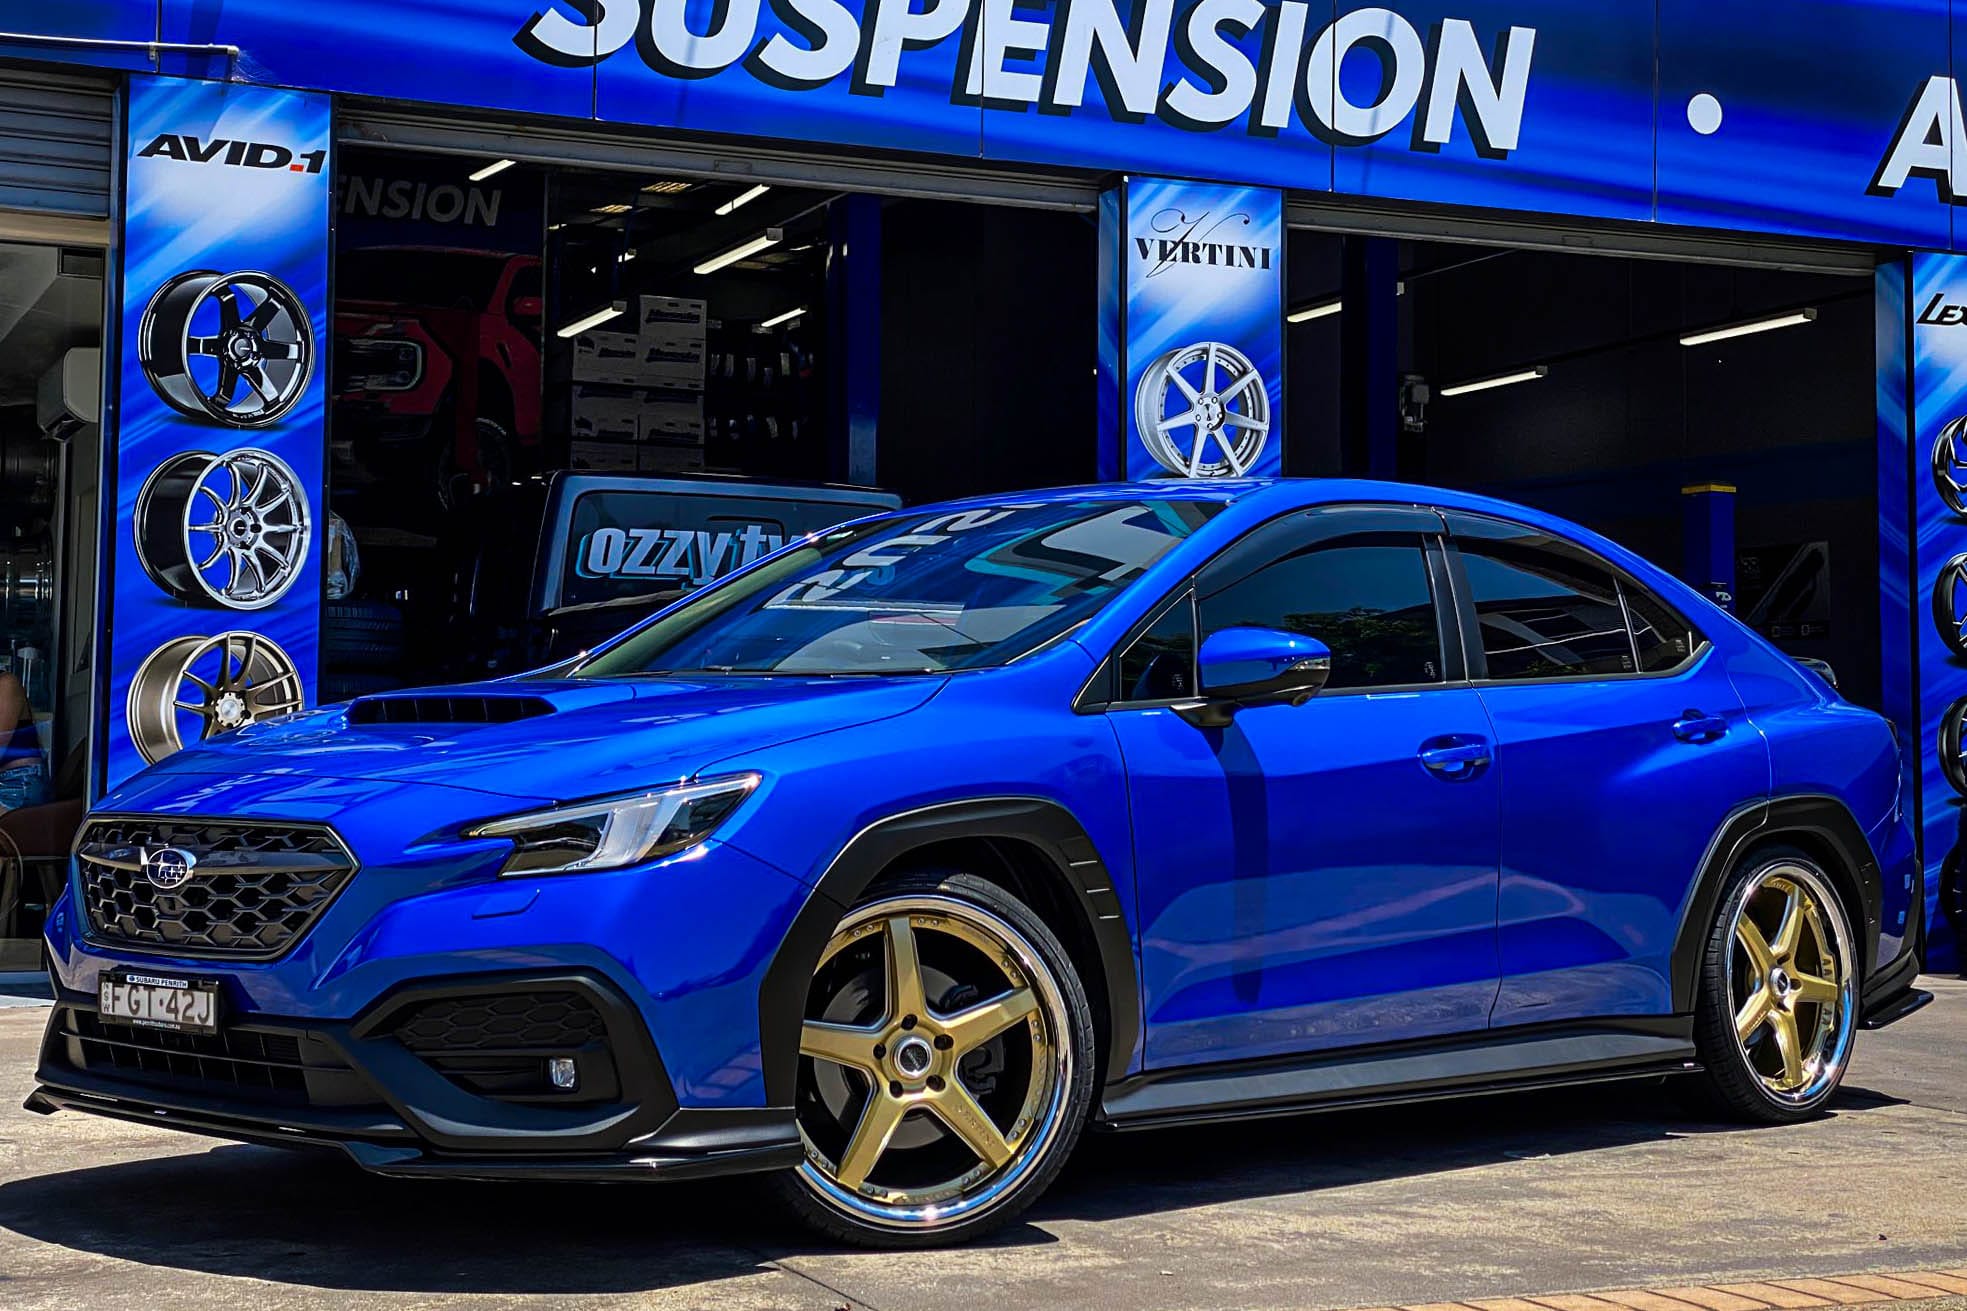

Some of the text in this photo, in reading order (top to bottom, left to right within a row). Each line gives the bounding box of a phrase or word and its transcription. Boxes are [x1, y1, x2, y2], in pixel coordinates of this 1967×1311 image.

[137, 134, 327, 174] AVID.1
[1135, 237, 1272, 270] VERTINI
[136, 976, 187, 988] SUBARU PENRITH
